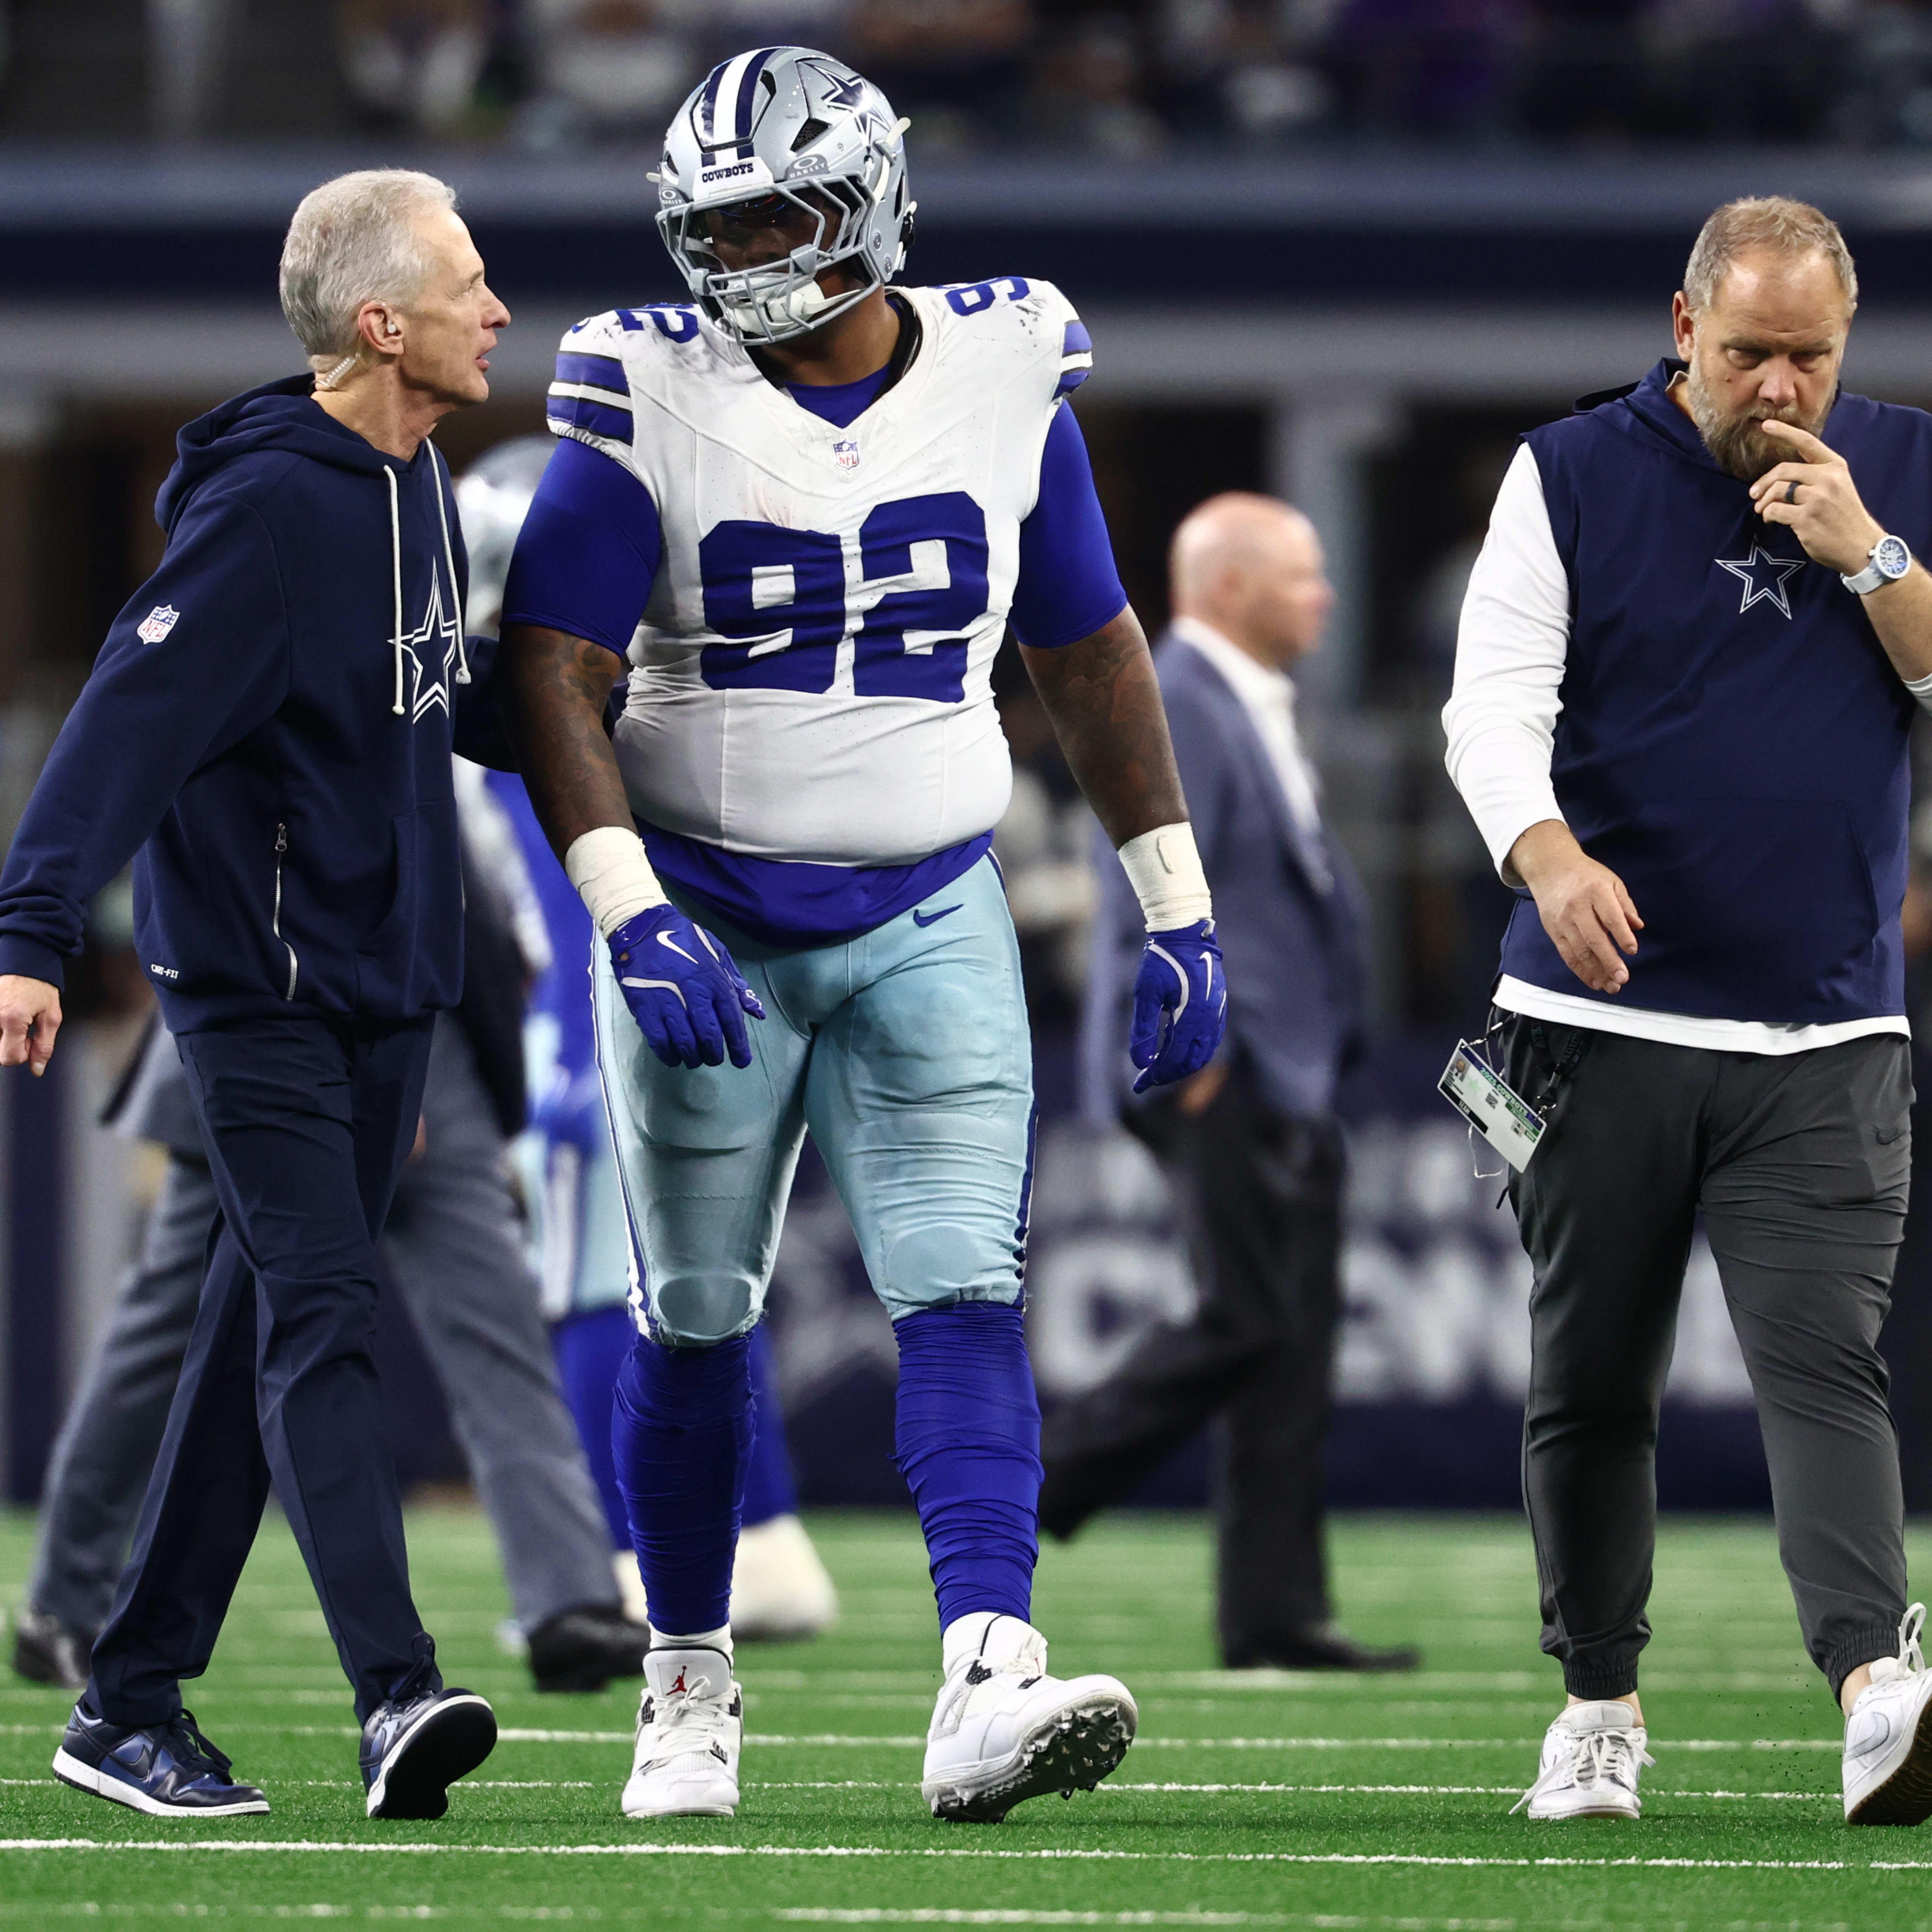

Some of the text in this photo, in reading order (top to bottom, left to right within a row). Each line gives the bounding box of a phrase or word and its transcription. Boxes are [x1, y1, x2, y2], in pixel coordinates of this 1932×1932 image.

[702, 163, 754, 183] COWBOYS
[789, 163, 825, 178] OAKLEY
[837, 453, 857, 466] NFL
[699, 491, 989, 703] 92
[142, 620, 166, 637] NFL
[1459, 1100, 1470, 1115] TEAM
[1496, 1084, 1528, 1116] COWBOYS
